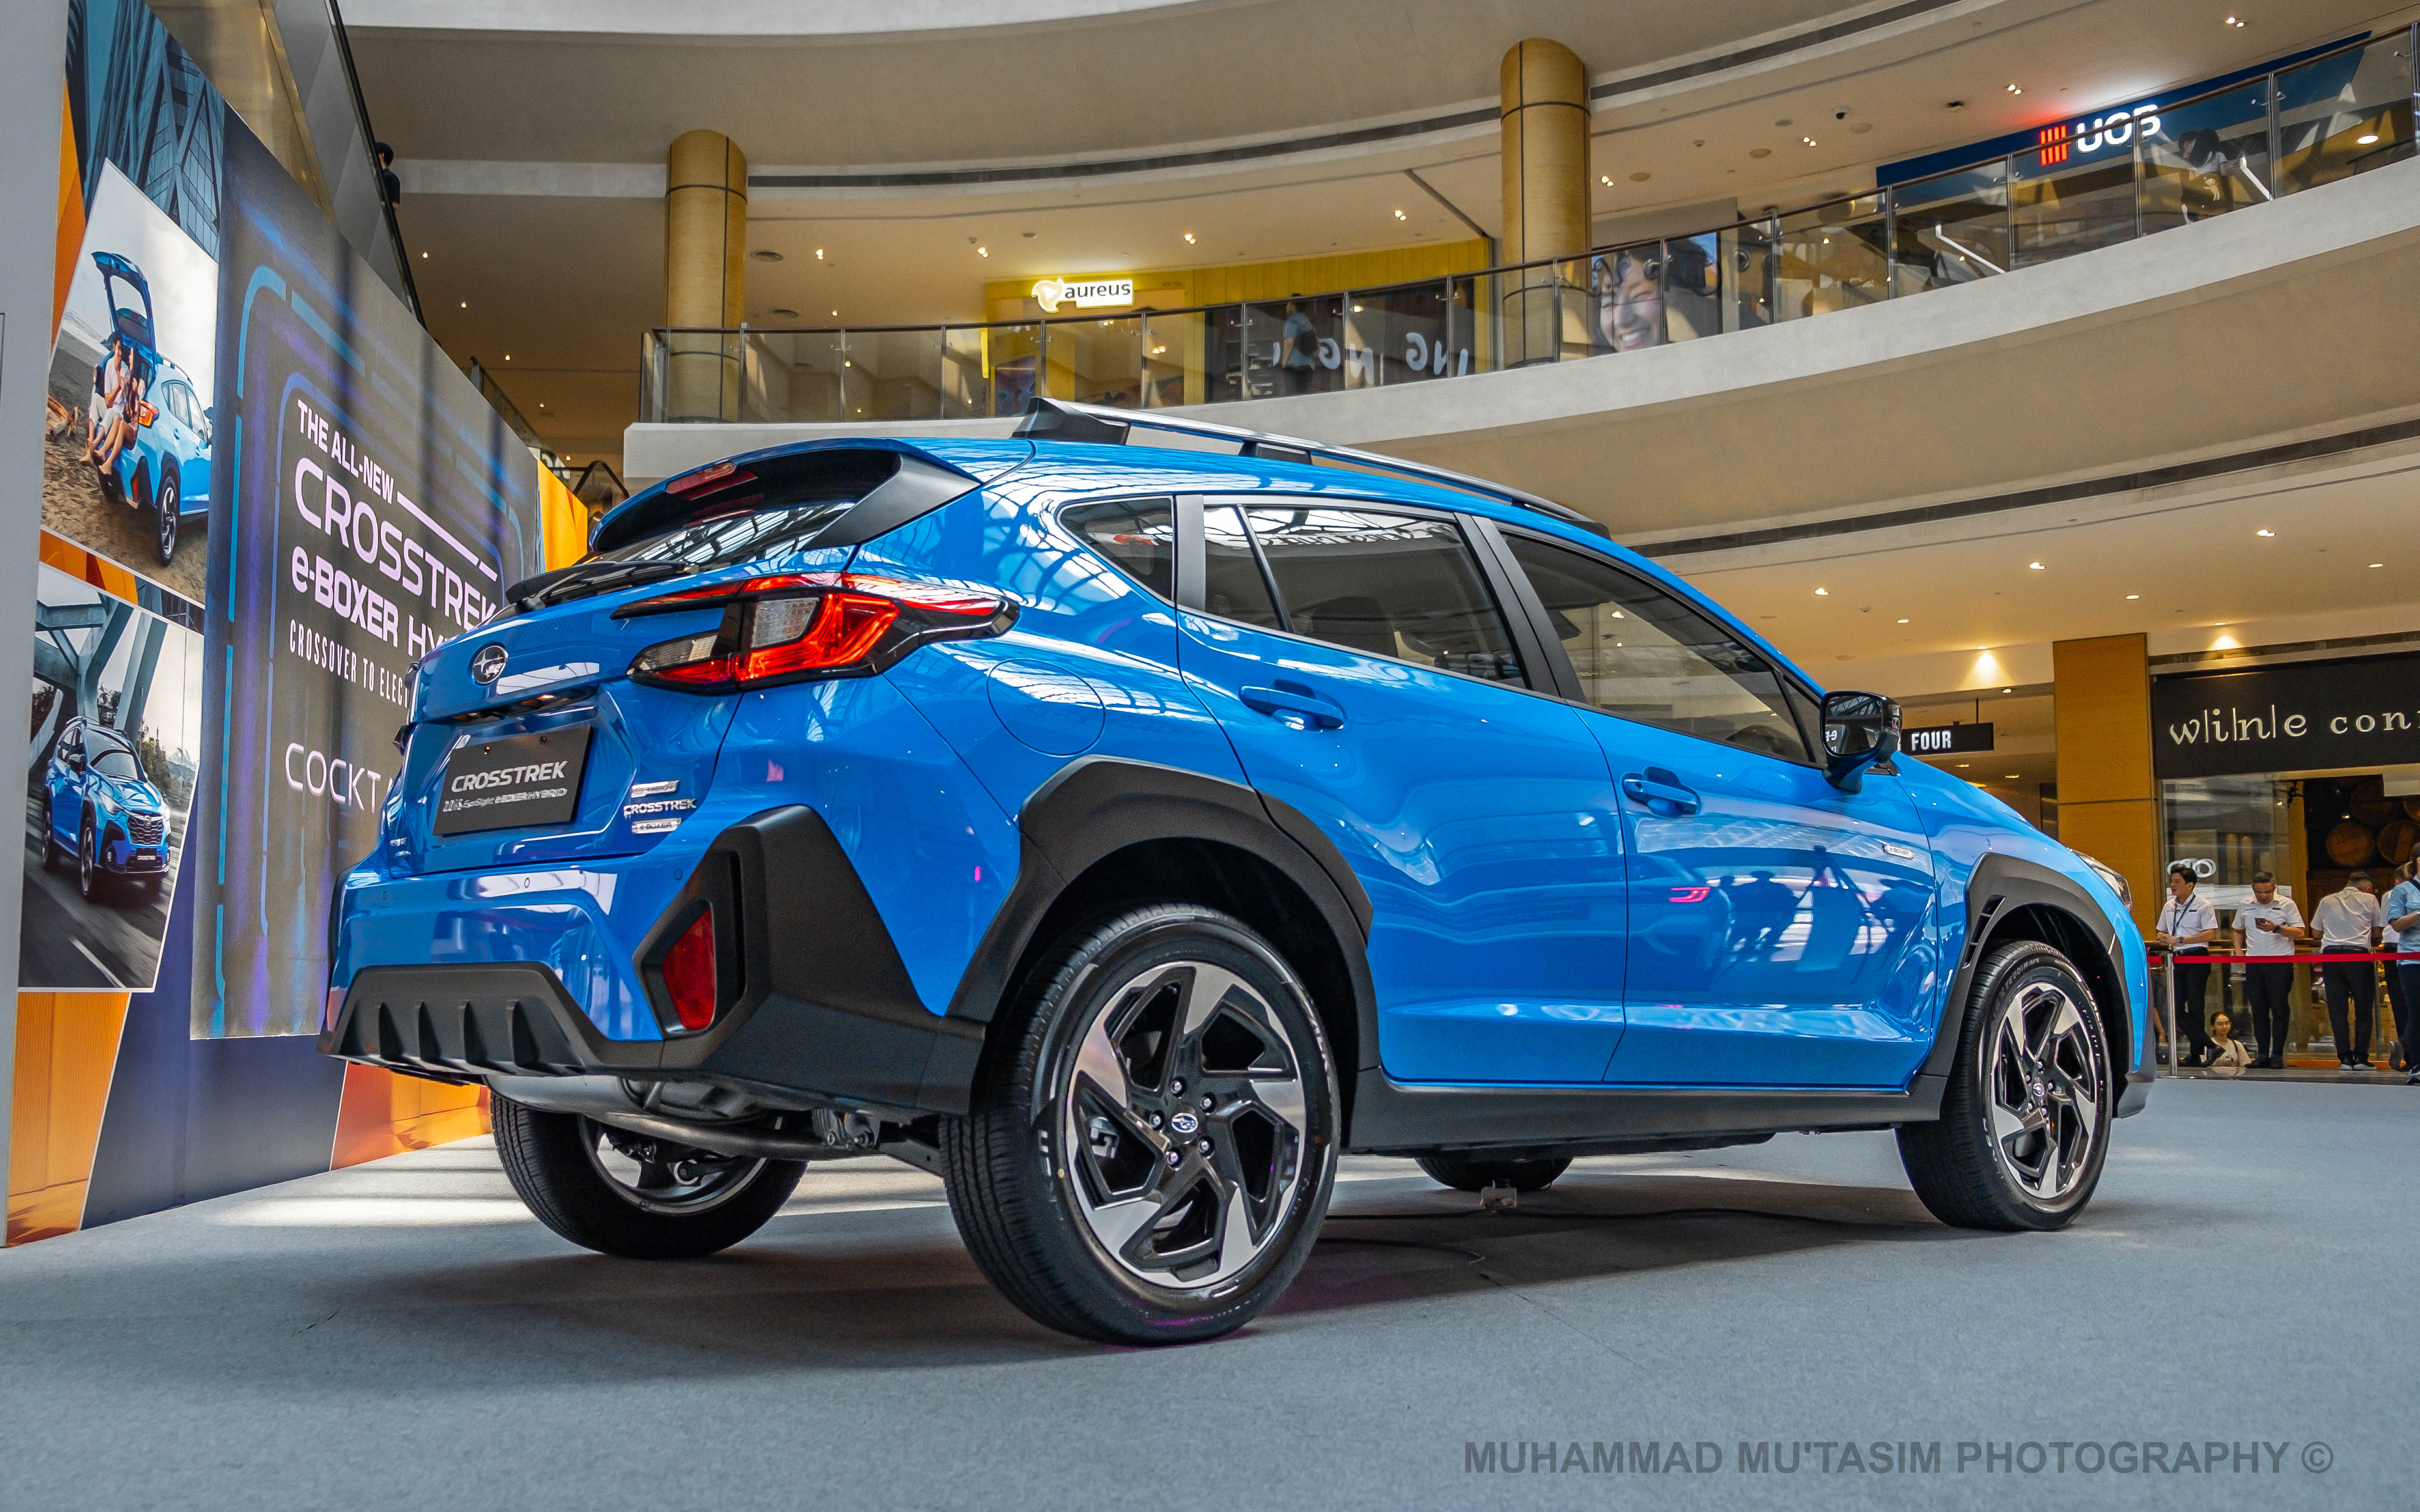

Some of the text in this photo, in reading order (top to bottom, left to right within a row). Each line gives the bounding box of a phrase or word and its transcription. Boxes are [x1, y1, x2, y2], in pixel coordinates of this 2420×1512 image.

[1065, 283, 1131, 299] aureus
[298, 399, 394, 504] THE ALL-NEW
[295, 458, 496, 634] CROSSTREK
[292, 546, 398, 648] e-BOXER
[290, 619, 357, 683] CROSSOVER
[363, 658, 375, 692] TO
[1911, 730, 1951, 751] FOUR
[2330, 711, 2420, 734] con
[285, 742, 393, 813] COCKT
[451, 761, 569, 792] CROSSTREK
[623, 798, 697, 817] CROSSTREK
